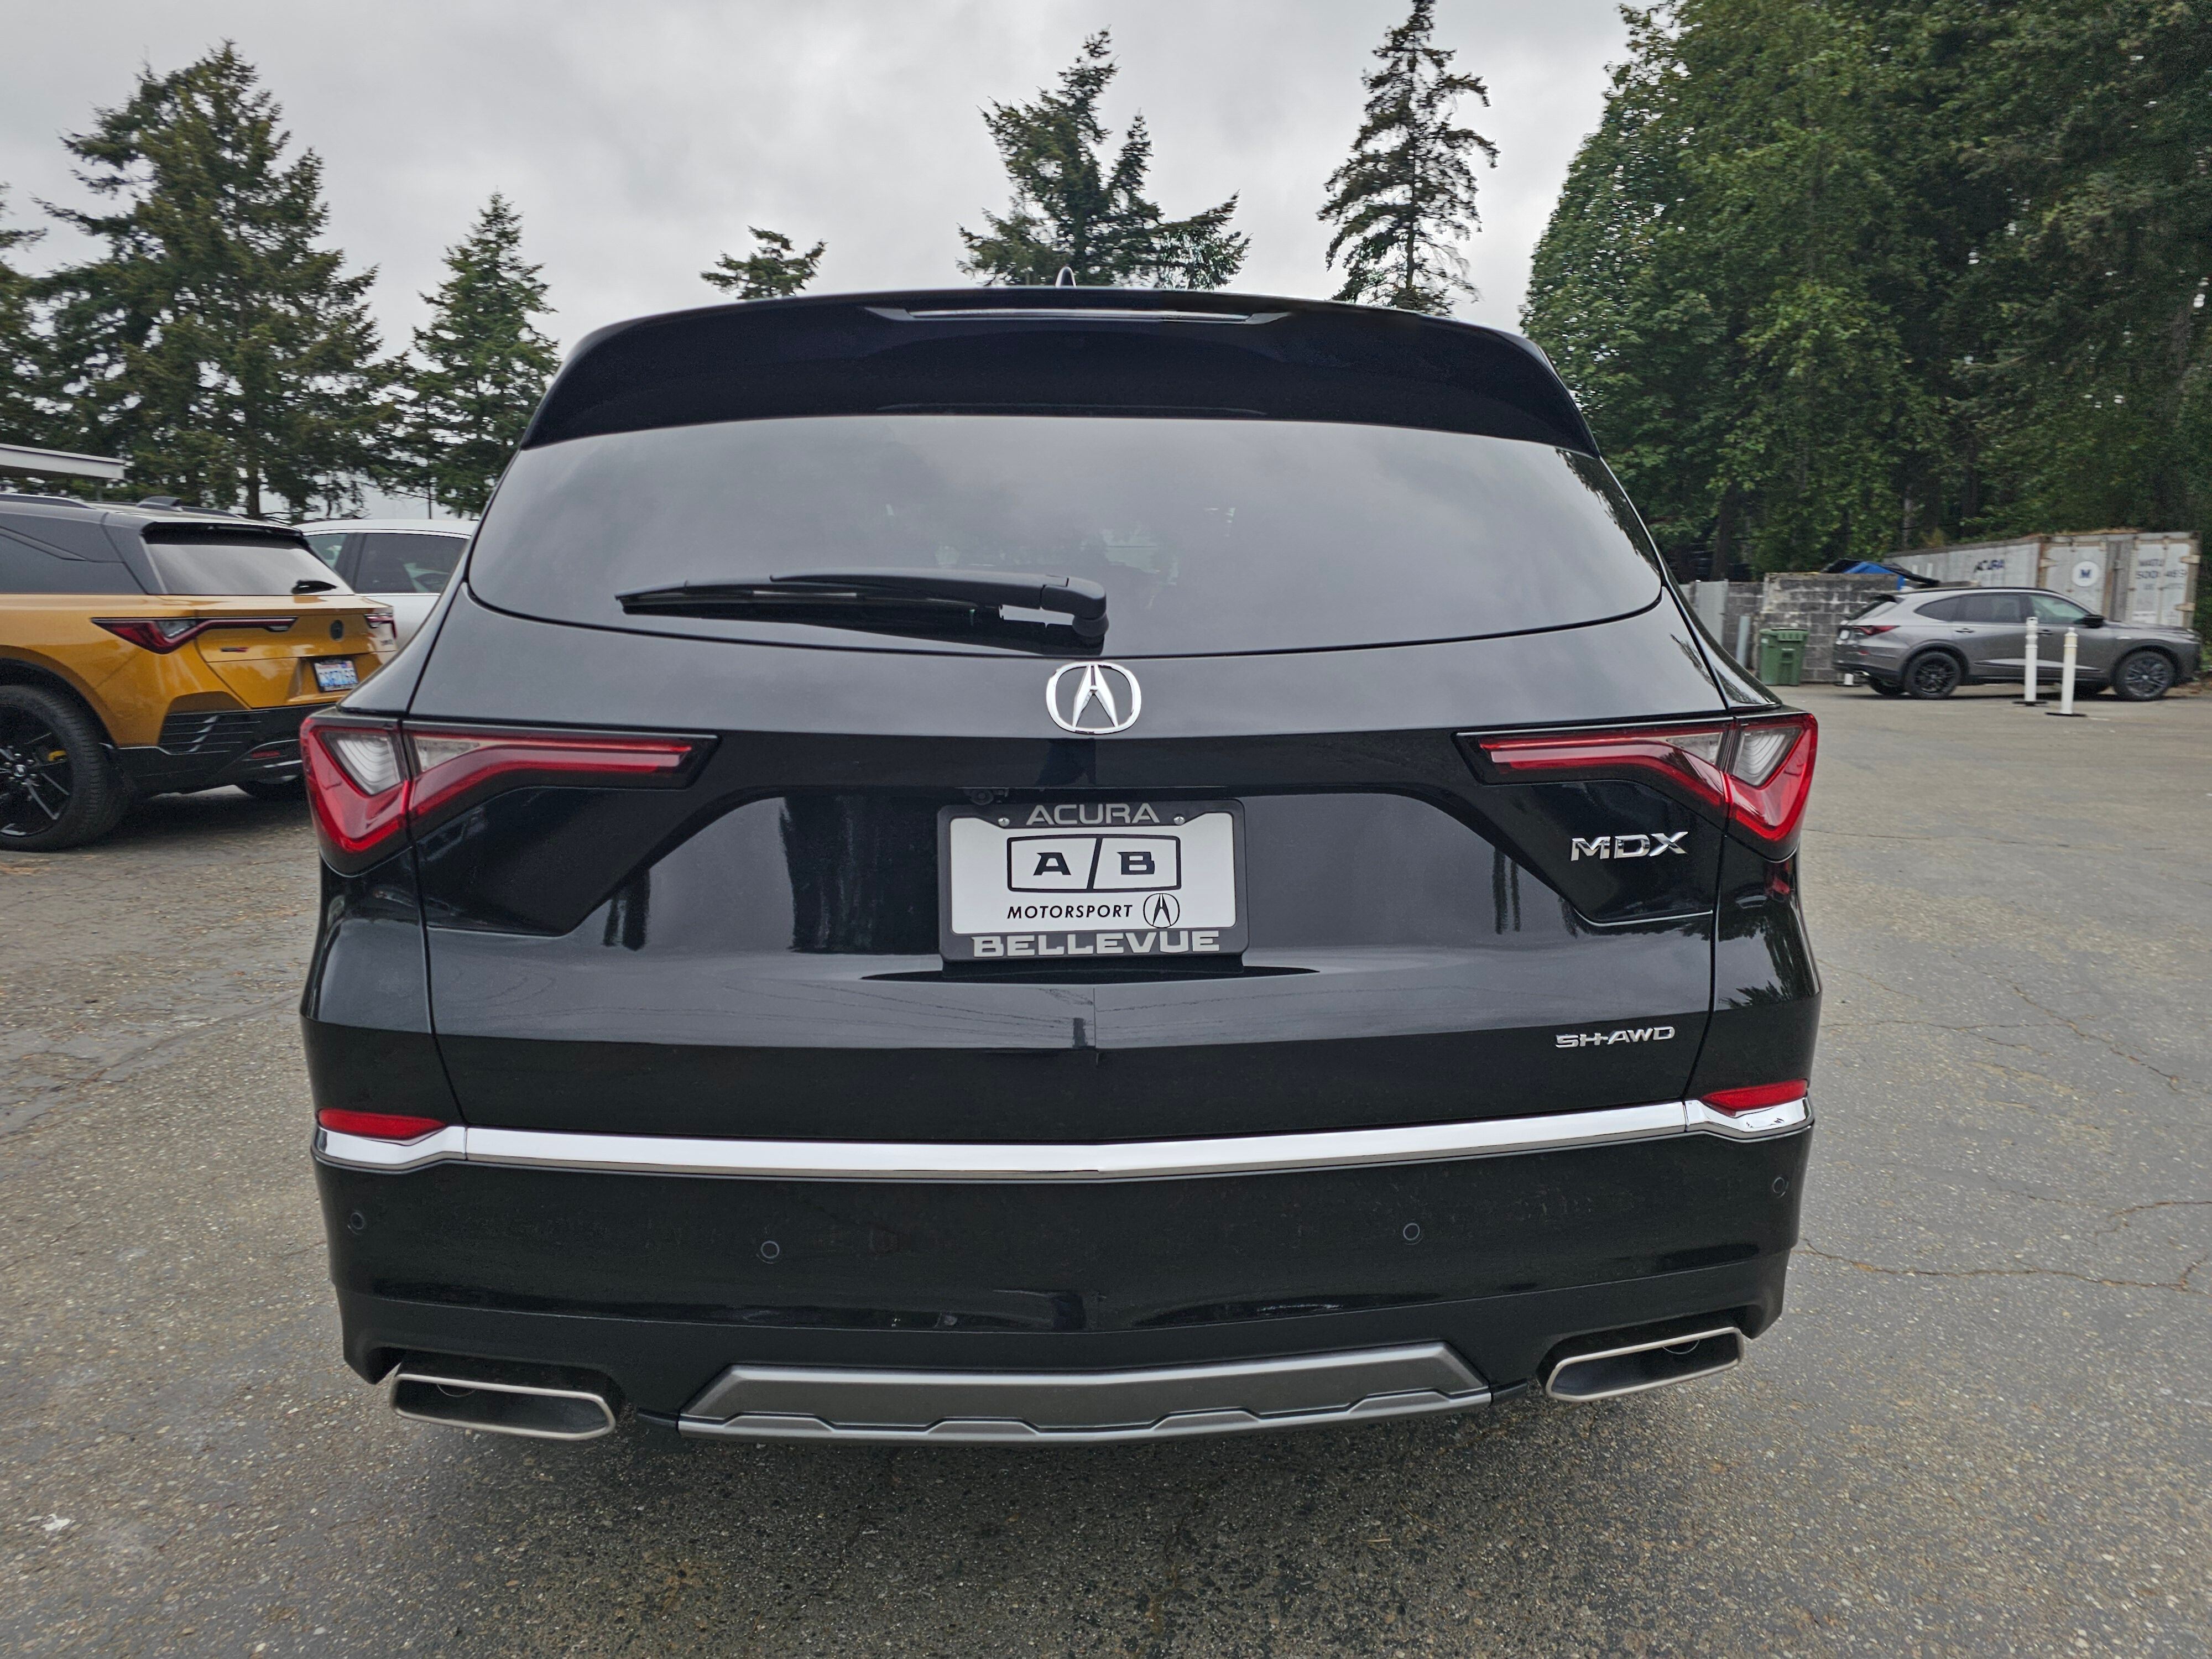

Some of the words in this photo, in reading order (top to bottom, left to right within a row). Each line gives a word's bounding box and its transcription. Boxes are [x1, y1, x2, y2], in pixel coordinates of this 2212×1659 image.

[1026, 803, 1160, 826] ACURA
[1571, 831, 1688, 862] MDX
[1006, 904, 1134, 920] MOTORSPORT
[971, 930, 1220, 958] BELLEVUE
[1555, 1026, 1676, 1048] SH-AWD
